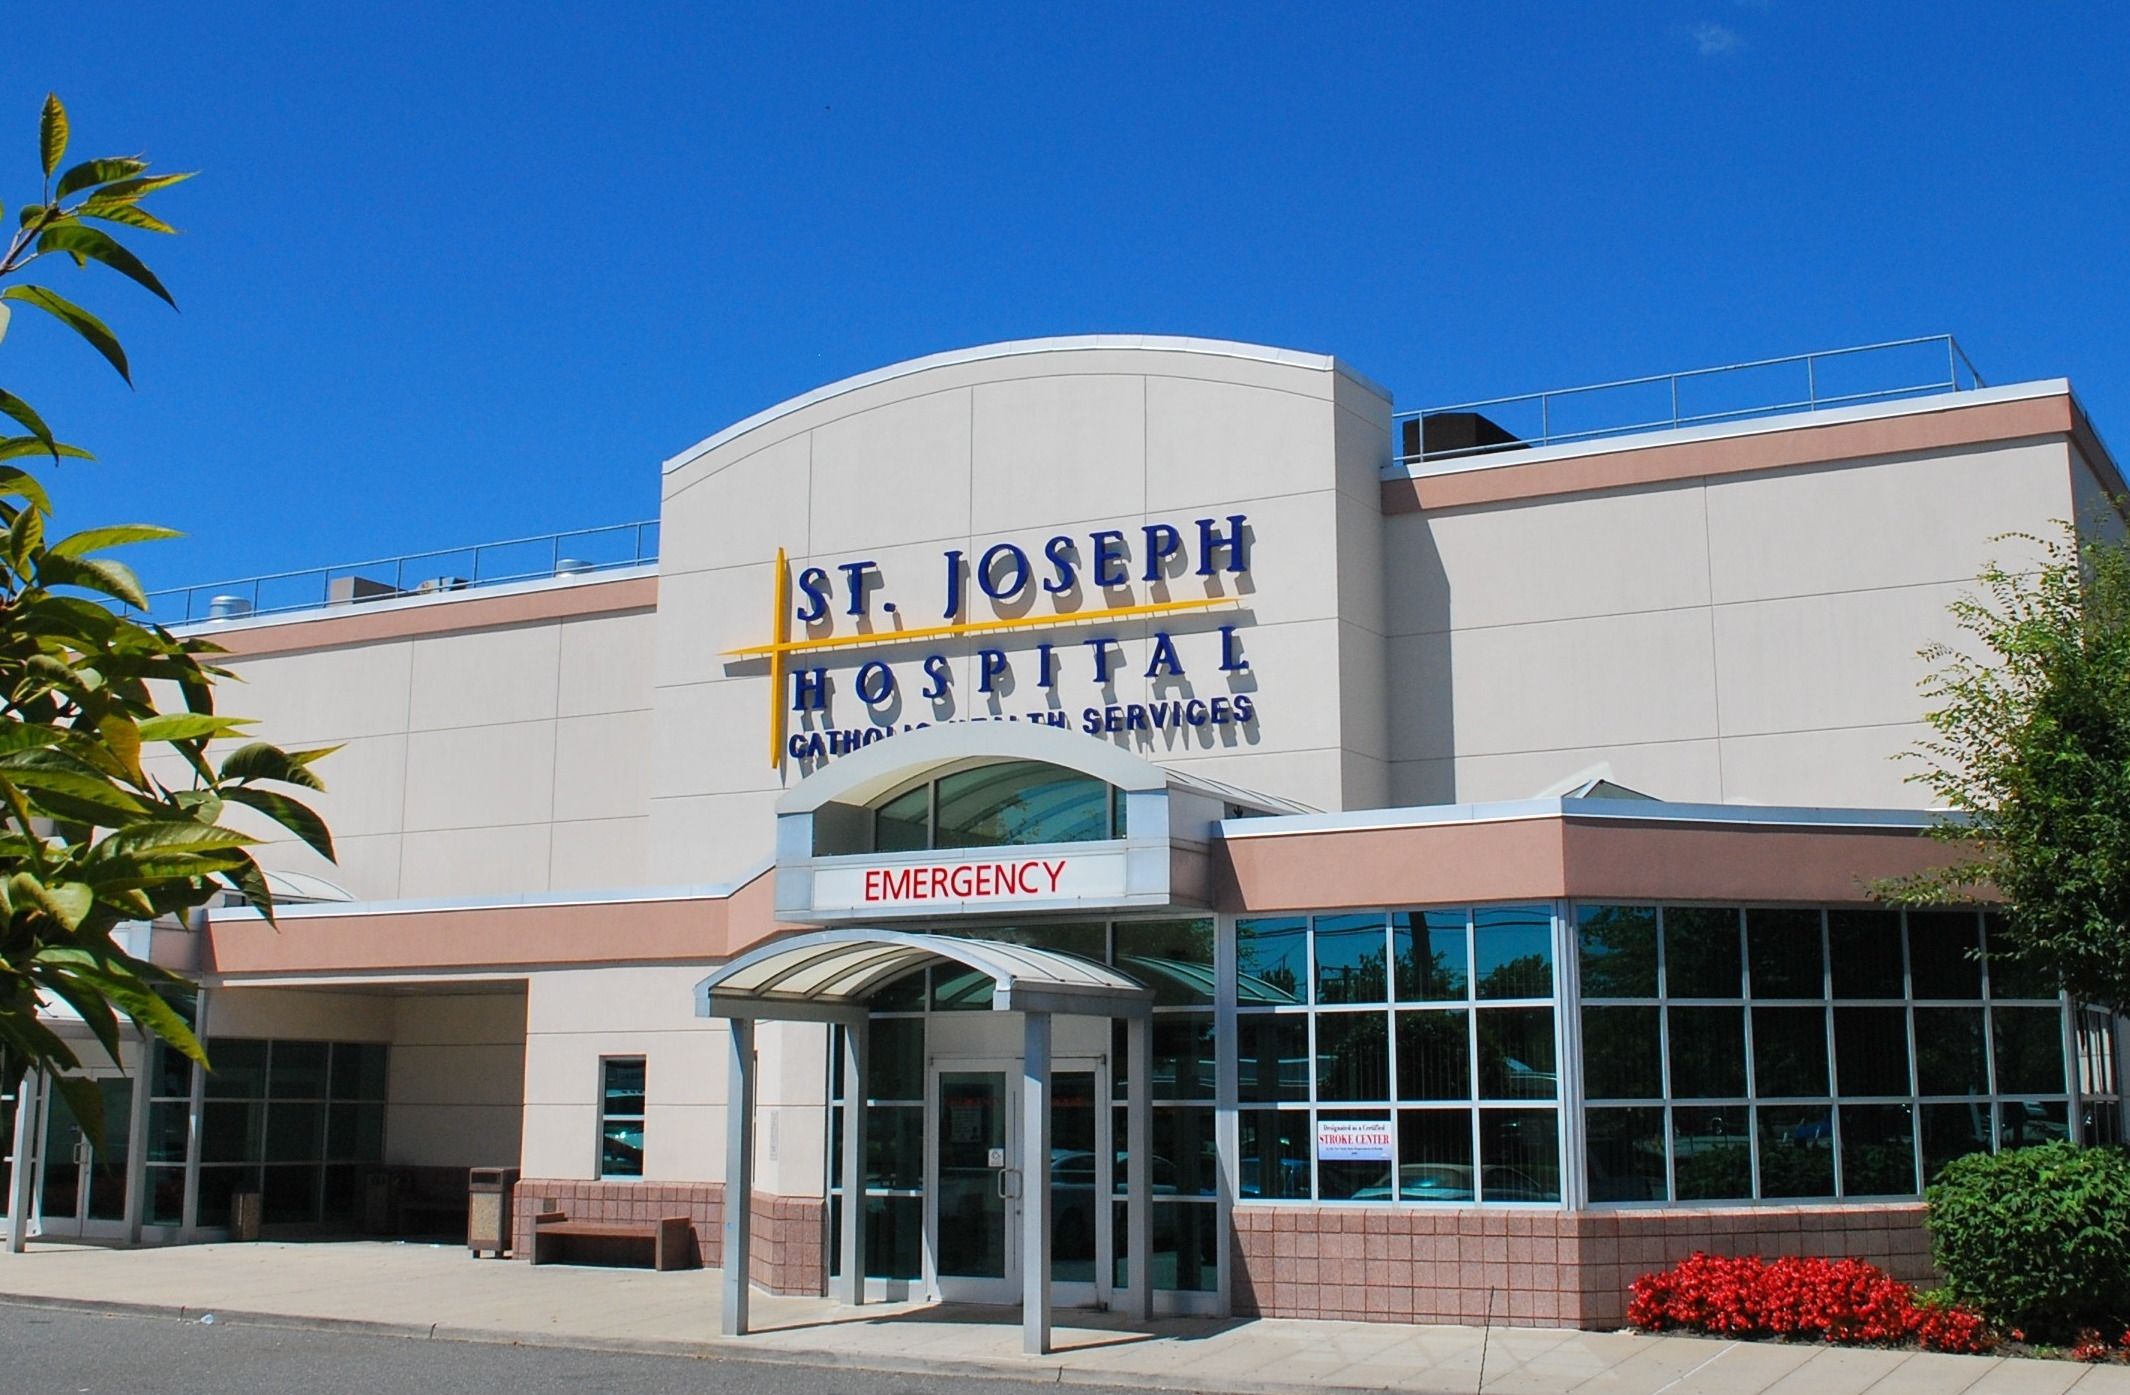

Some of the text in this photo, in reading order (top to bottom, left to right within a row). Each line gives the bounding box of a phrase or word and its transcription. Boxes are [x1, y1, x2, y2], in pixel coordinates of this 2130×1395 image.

[797, 514, 1248, 622] ST. JOSEPH
[791, 625, 1250, 711] HOSPITAL
[789, 722, 931, 758] CATHO
[1082, 695, 1253, 734] SERVICES
[865, 861, 1066, 901] EMERGENCY
[1319, 1134, 1389, 1144] STROKE CENTER
